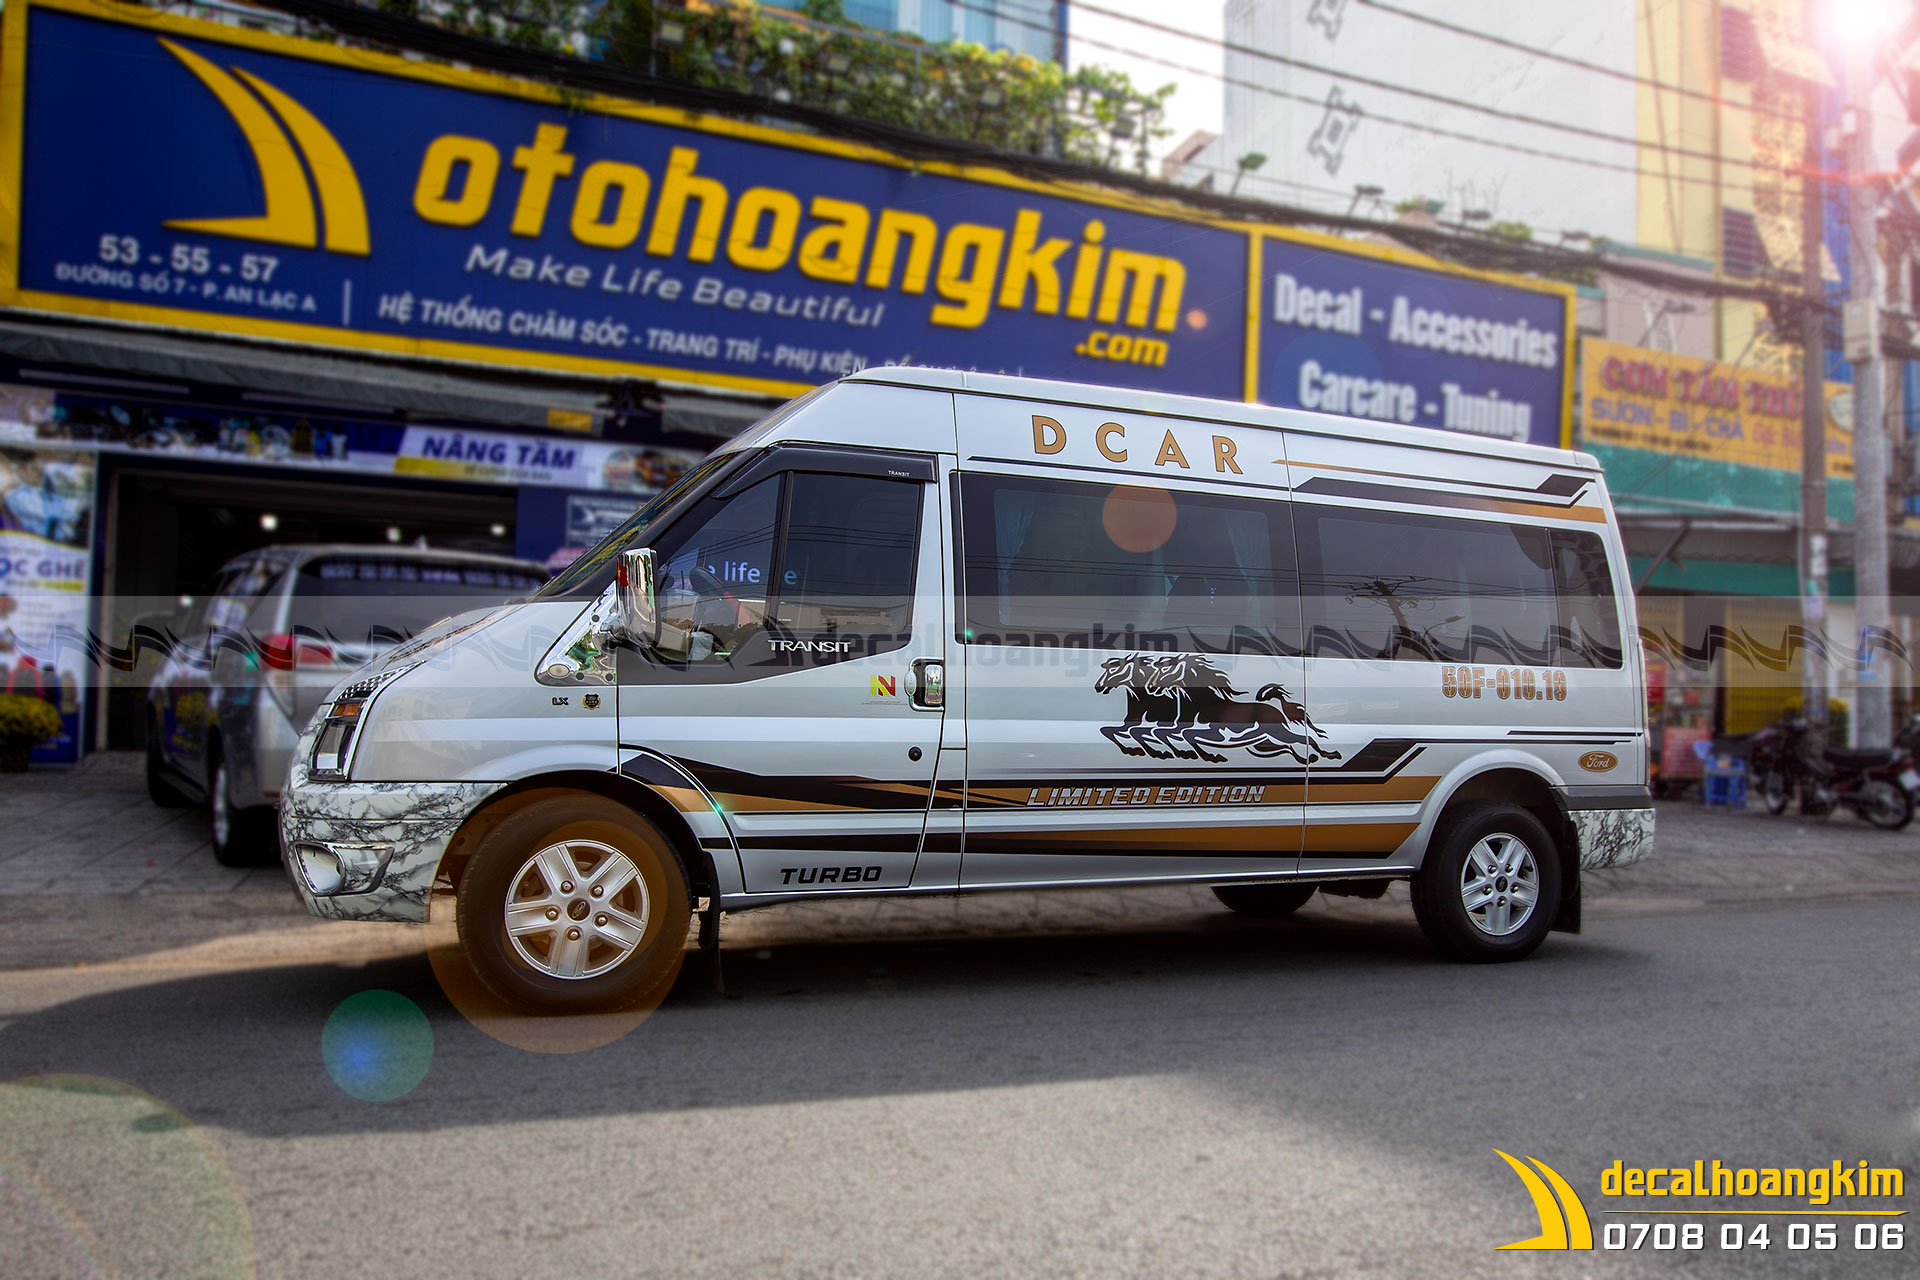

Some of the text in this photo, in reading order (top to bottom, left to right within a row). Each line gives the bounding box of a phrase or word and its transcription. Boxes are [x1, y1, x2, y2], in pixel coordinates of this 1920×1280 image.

[414, 123, 1186, 328] otohoangkim
[99, 234, 140, 264] 53
[171, 244, 210, 274] 55
[240, 253, 279, 284] 57
[174, 278, 186, 294] 7
[223, 284, 252, 304] AN
[301, 295, 317, 312] A
[464, 244, 886, 328] Make Life Beautiful
[378, 290, 415, 325] HỆ
[420, 294, 504, 333] THỐNG
[580, 315, 630, 348] SÓC
[646, 328, 719, 360] TRANG
[725, 336, 761, 365] TRÍ
[773, 343, 818, 376] PHỤ
[1274, 272, 1363, 337] Decal
[1388, 295, 1559, 370] Accessories
[1075, 330, 1169, 367] .com
[1298, 359, 1418, 424] Carcare
[1440, 381, 1533, 444] Tuning
[1031, 414, 1244, 475] DCAR
[888, 469, 911, 477] TRANSIT
[724, 561, 760, 583] life
[767, 639, 852, 655] TRANSIT
[552, 696, 569, 706] LX
[1026, 785, 1266, 807] LIMITED EDITION
[780, 866, 883, 885] TURBO
